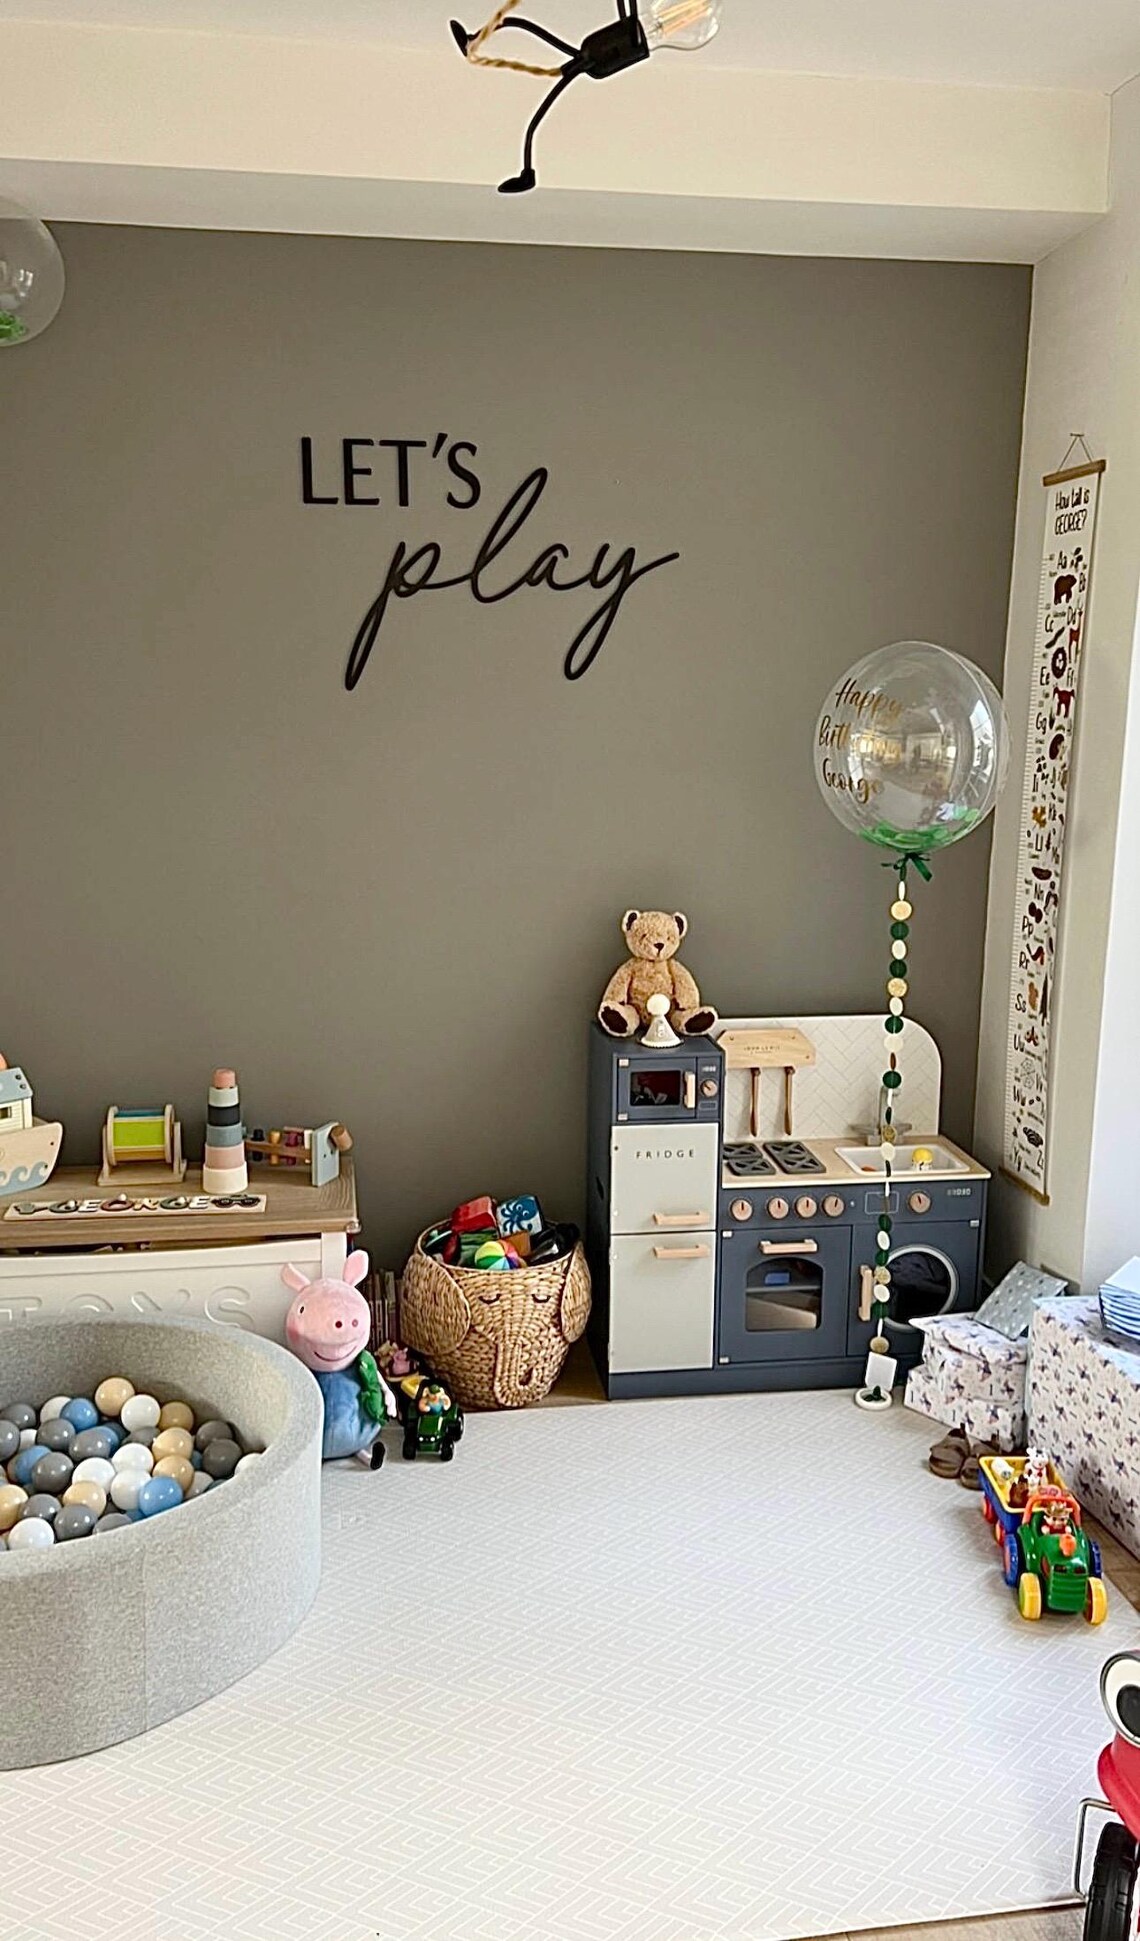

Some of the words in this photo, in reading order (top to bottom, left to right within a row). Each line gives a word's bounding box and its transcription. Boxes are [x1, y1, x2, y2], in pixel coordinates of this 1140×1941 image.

[301, 433, 481, 509] LET'S
[344, 467, 680, 691] play
[835, 677, 905, 720] Happy
[636, 1149, 695, 1160] FRIDGE
[49, 1193, 212, 1214] GEORGE
